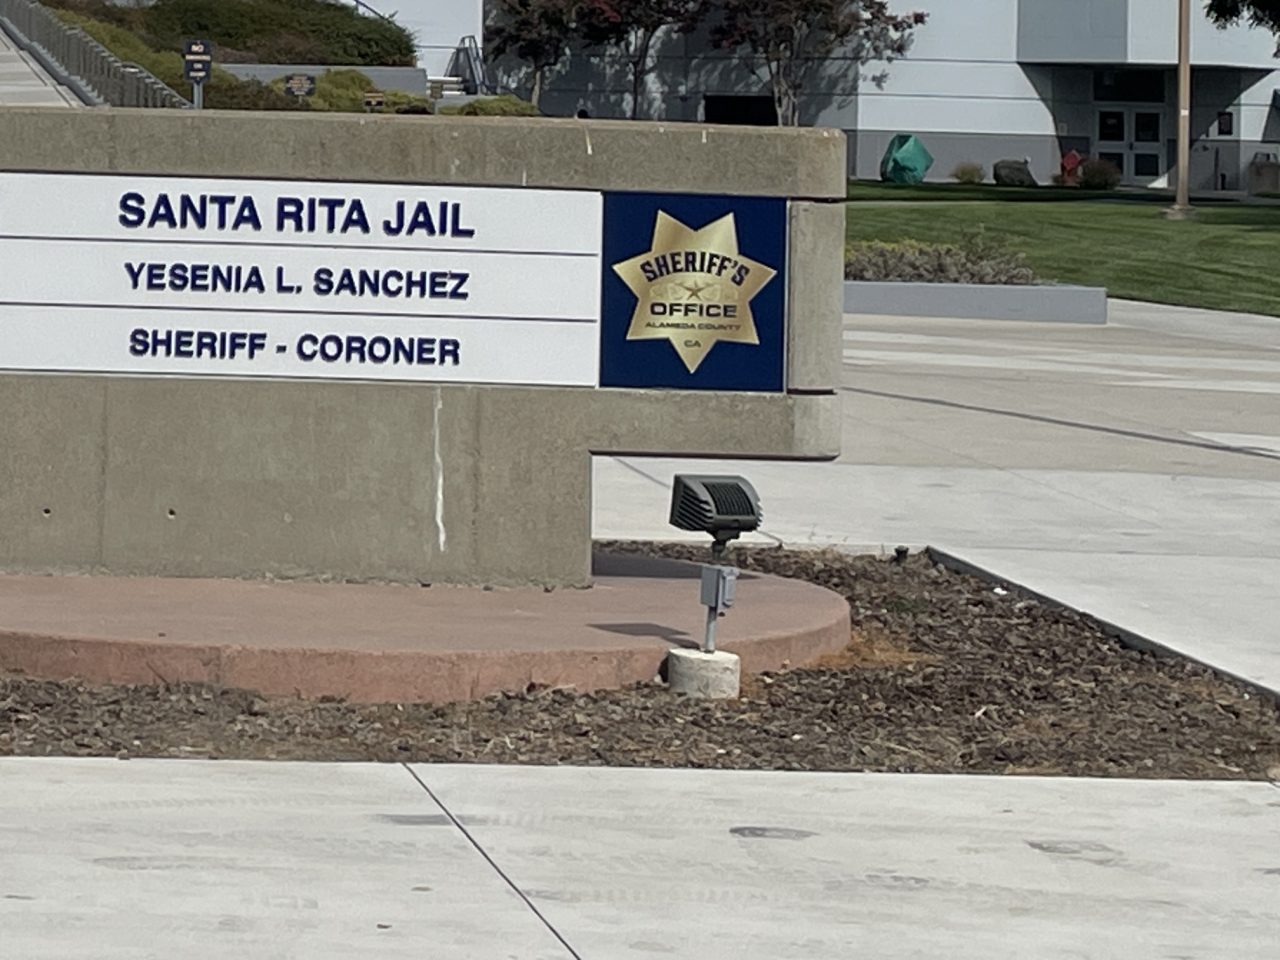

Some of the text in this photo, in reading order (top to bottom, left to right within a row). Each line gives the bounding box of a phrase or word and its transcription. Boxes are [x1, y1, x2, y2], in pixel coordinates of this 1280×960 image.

[118, 192, 475, 238] SANTA RITA JAIL
[124, 261, 470, 300] YESENIA L. SANCHEZ
[639, 251, 750, 286] SHERIFF'S
[644, 321, 742, 331] ALAMEDA COUNTY
[650, 302, 737, 317] OFFICE
[128, 328, 461, 366] SHERIFF - CORONER
[683, 340, 702, 348] CA
